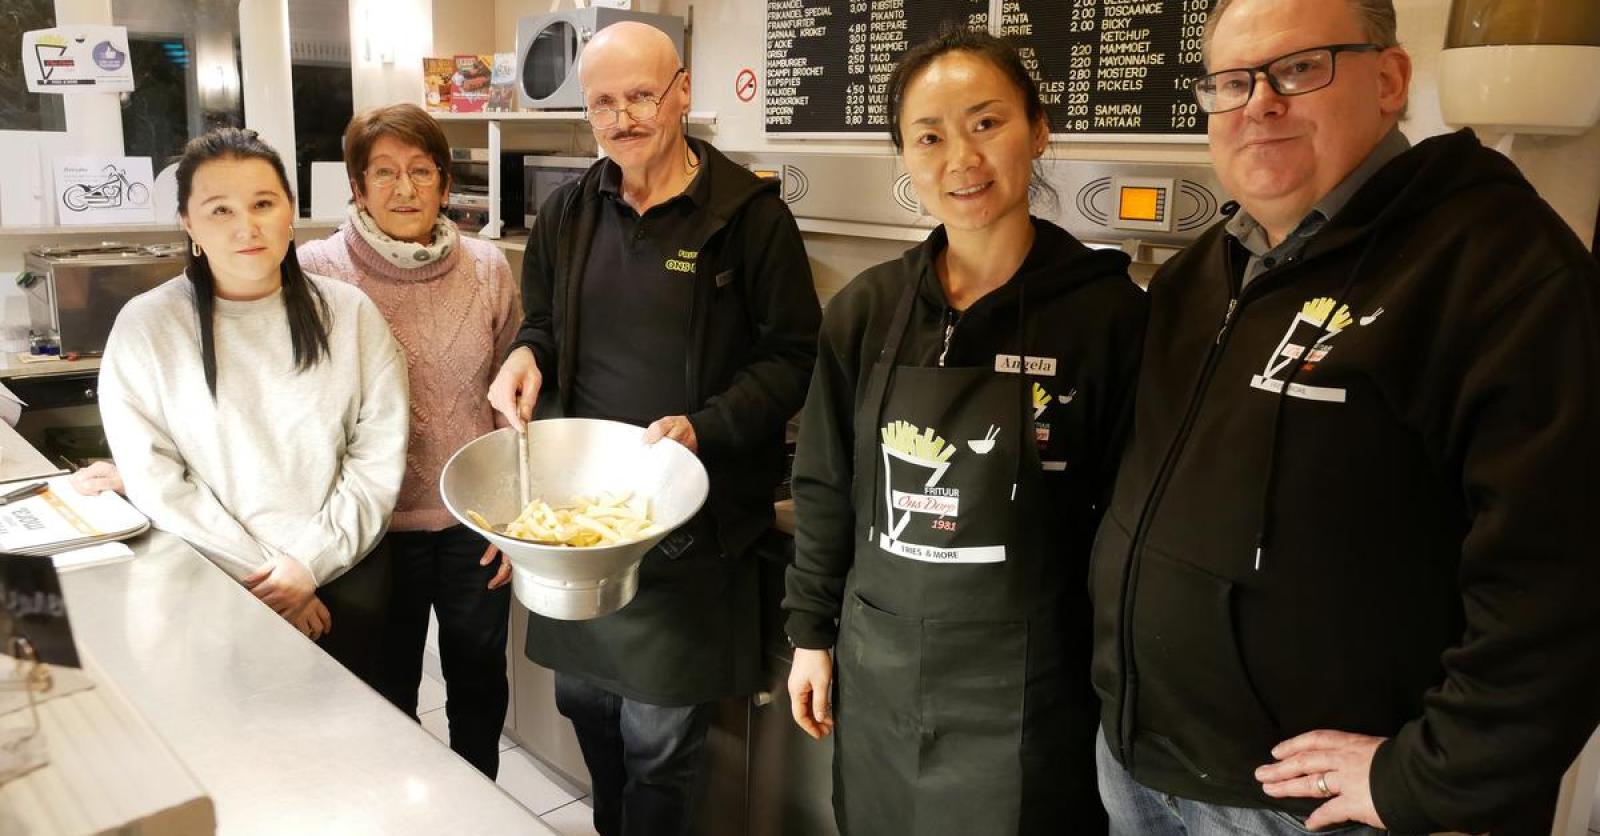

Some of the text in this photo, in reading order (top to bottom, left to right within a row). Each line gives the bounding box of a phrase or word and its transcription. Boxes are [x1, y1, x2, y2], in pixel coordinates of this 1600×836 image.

[1003, 3, 1020, 13] SPA
[871, 9, 905, 20] PIKANTO
[1002, 13, 1029, 24] FANTA
[870, 20, 907, 31] PREPARE
[1102, 18, 1132, 30] BICKY
[1001, 25, 1032, 36] SPRITE
[1101, 29, 1151, 41] KETCHUP
[870, 41, 908, 52] MAMMOET
[1100, 42, 1151, 54] MAMMOET
[767, 58, 807, 68] HAMBURGER
[870, 53, 890, 62] TACO
[1099, 54, 1166, 66] MAYONNAISE
[1097, 67, 1148, 79] MOSTERD
[1040, 82, 1065, 92] FLES
[1097, 80, 1143, 91] PICKELS
[1095, 105, 1142, 116] SAMURAI
[1094, 117, 1141, 128] TARTAAR
[924, 487, 960, 498] FRITUUR
[898, 496, 922, 509] Ons
[931, 520, 958, 532] 1981
[933, 550, 959, 560] MORE
